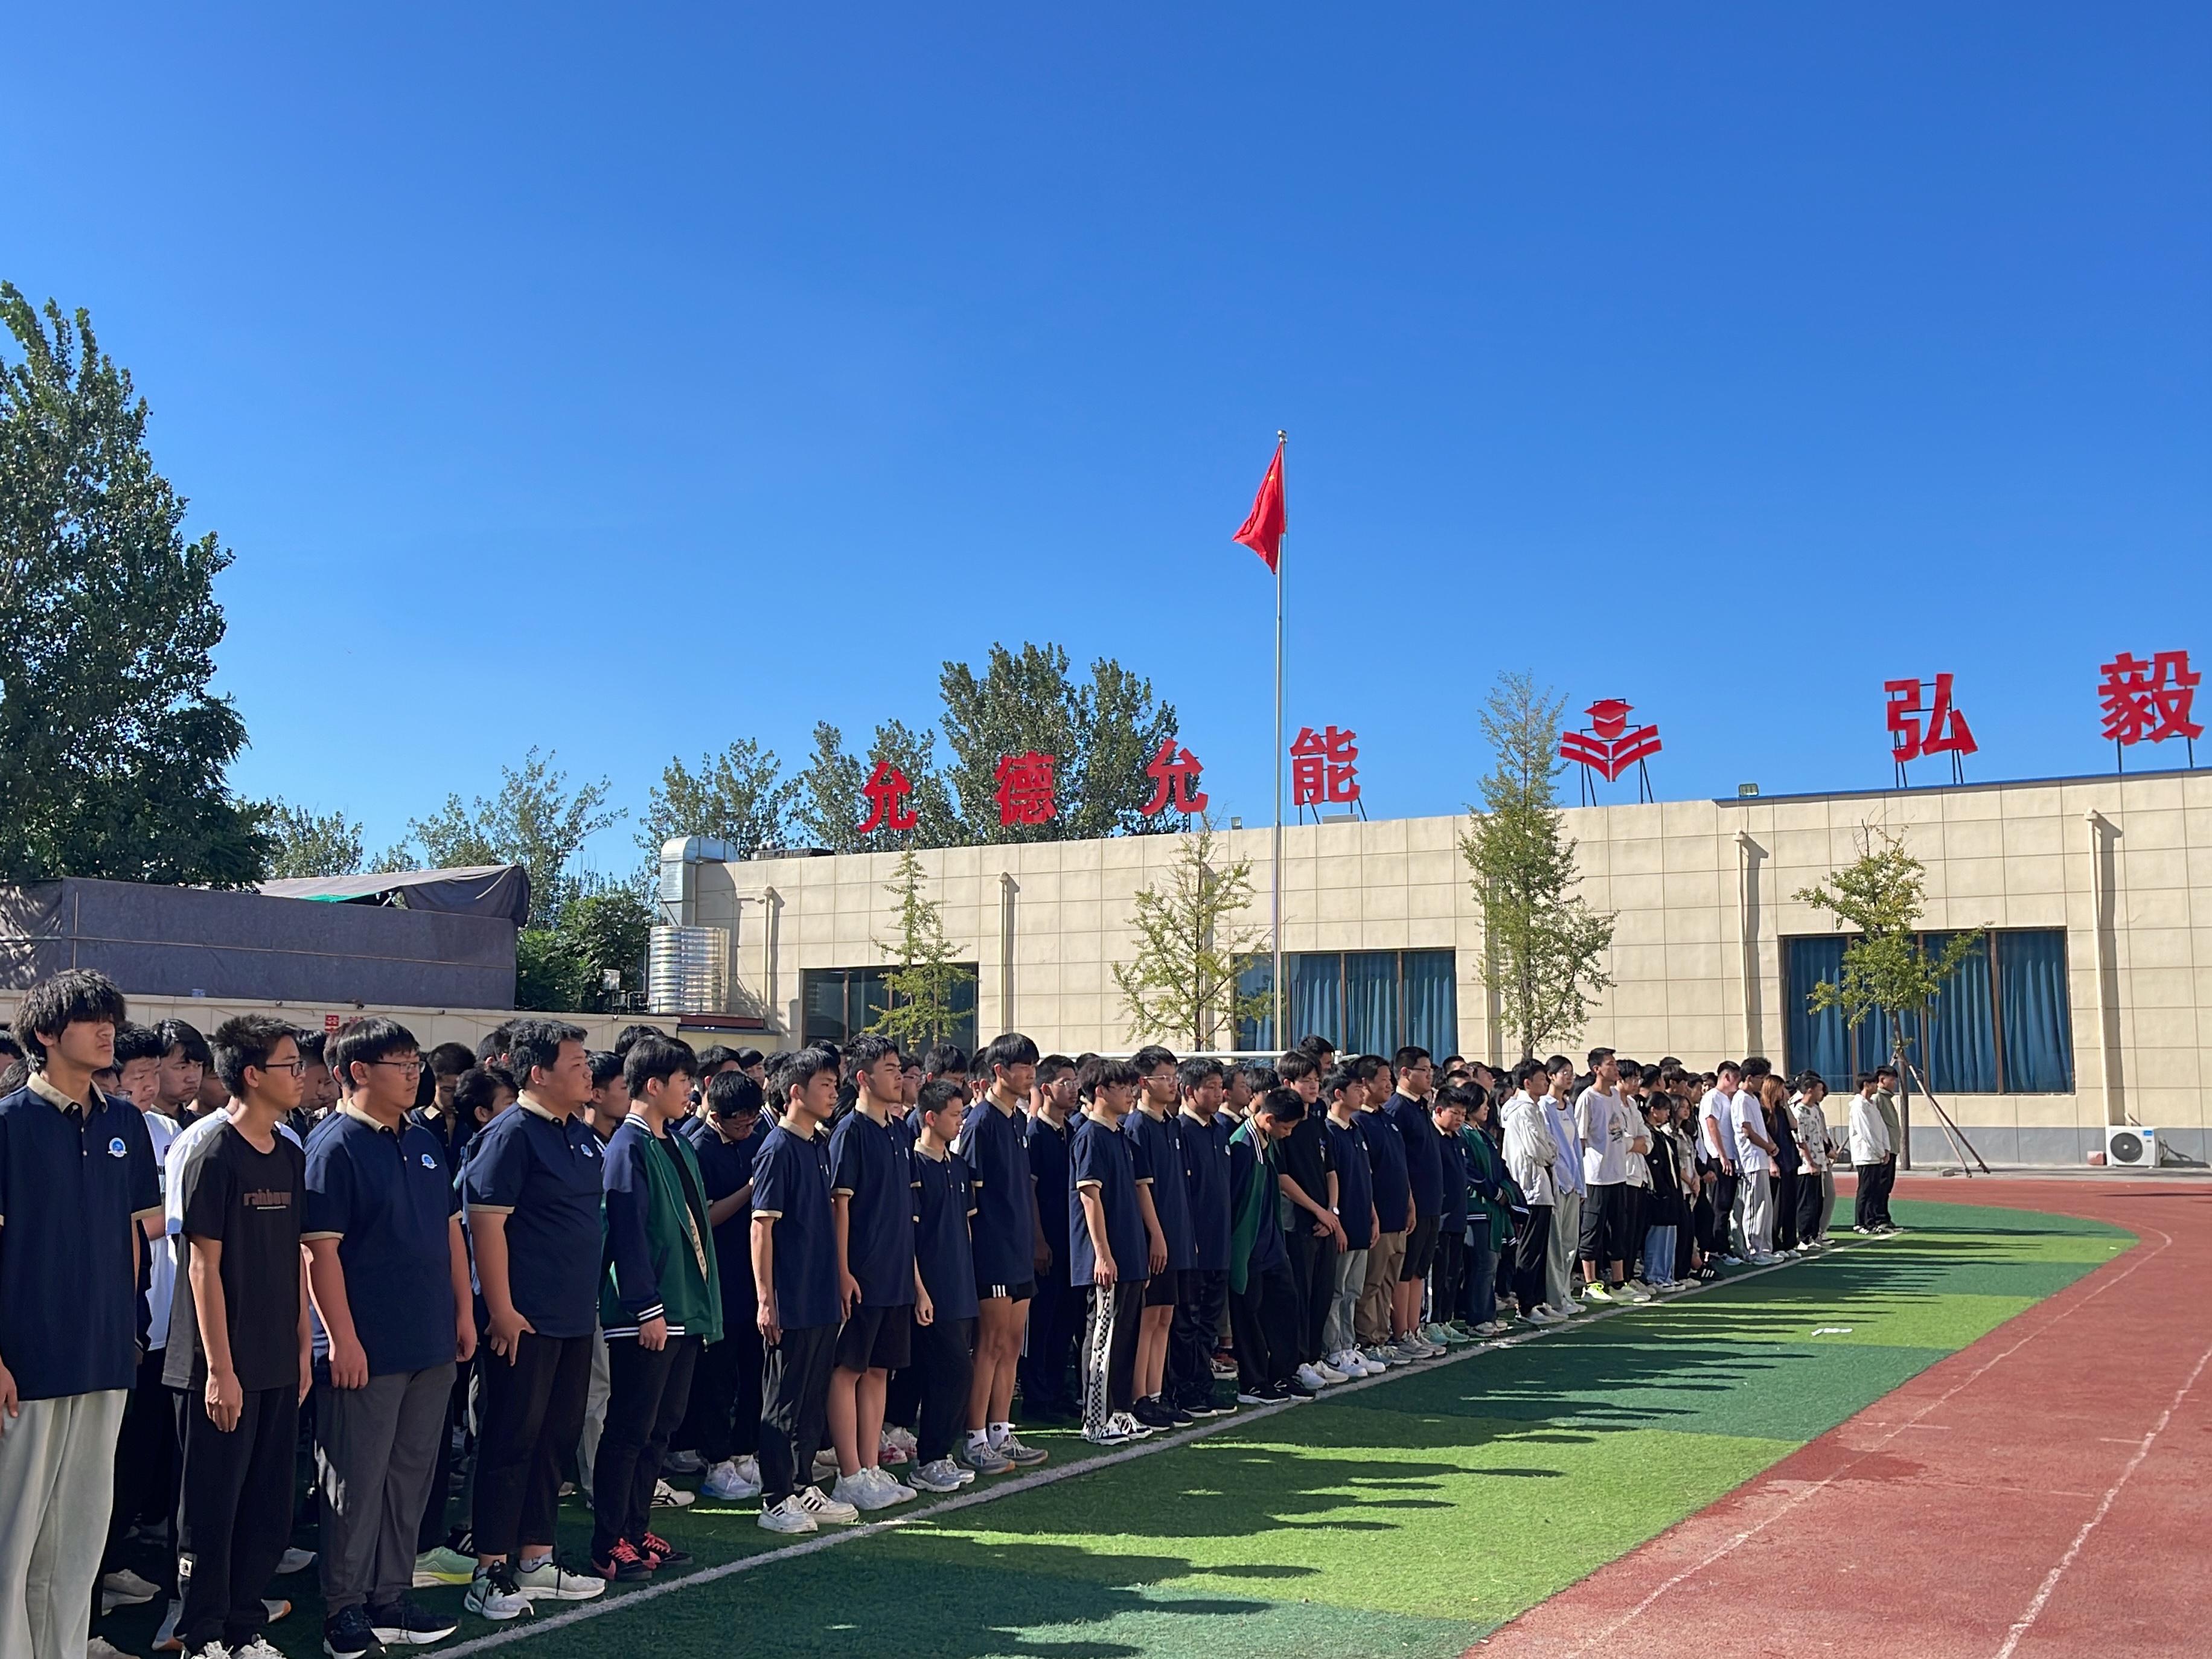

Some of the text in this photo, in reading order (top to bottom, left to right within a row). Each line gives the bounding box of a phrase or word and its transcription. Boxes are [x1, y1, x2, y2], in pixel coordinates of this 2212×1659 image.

[858, 650, 2204, 833] 允德允能 弘毅
